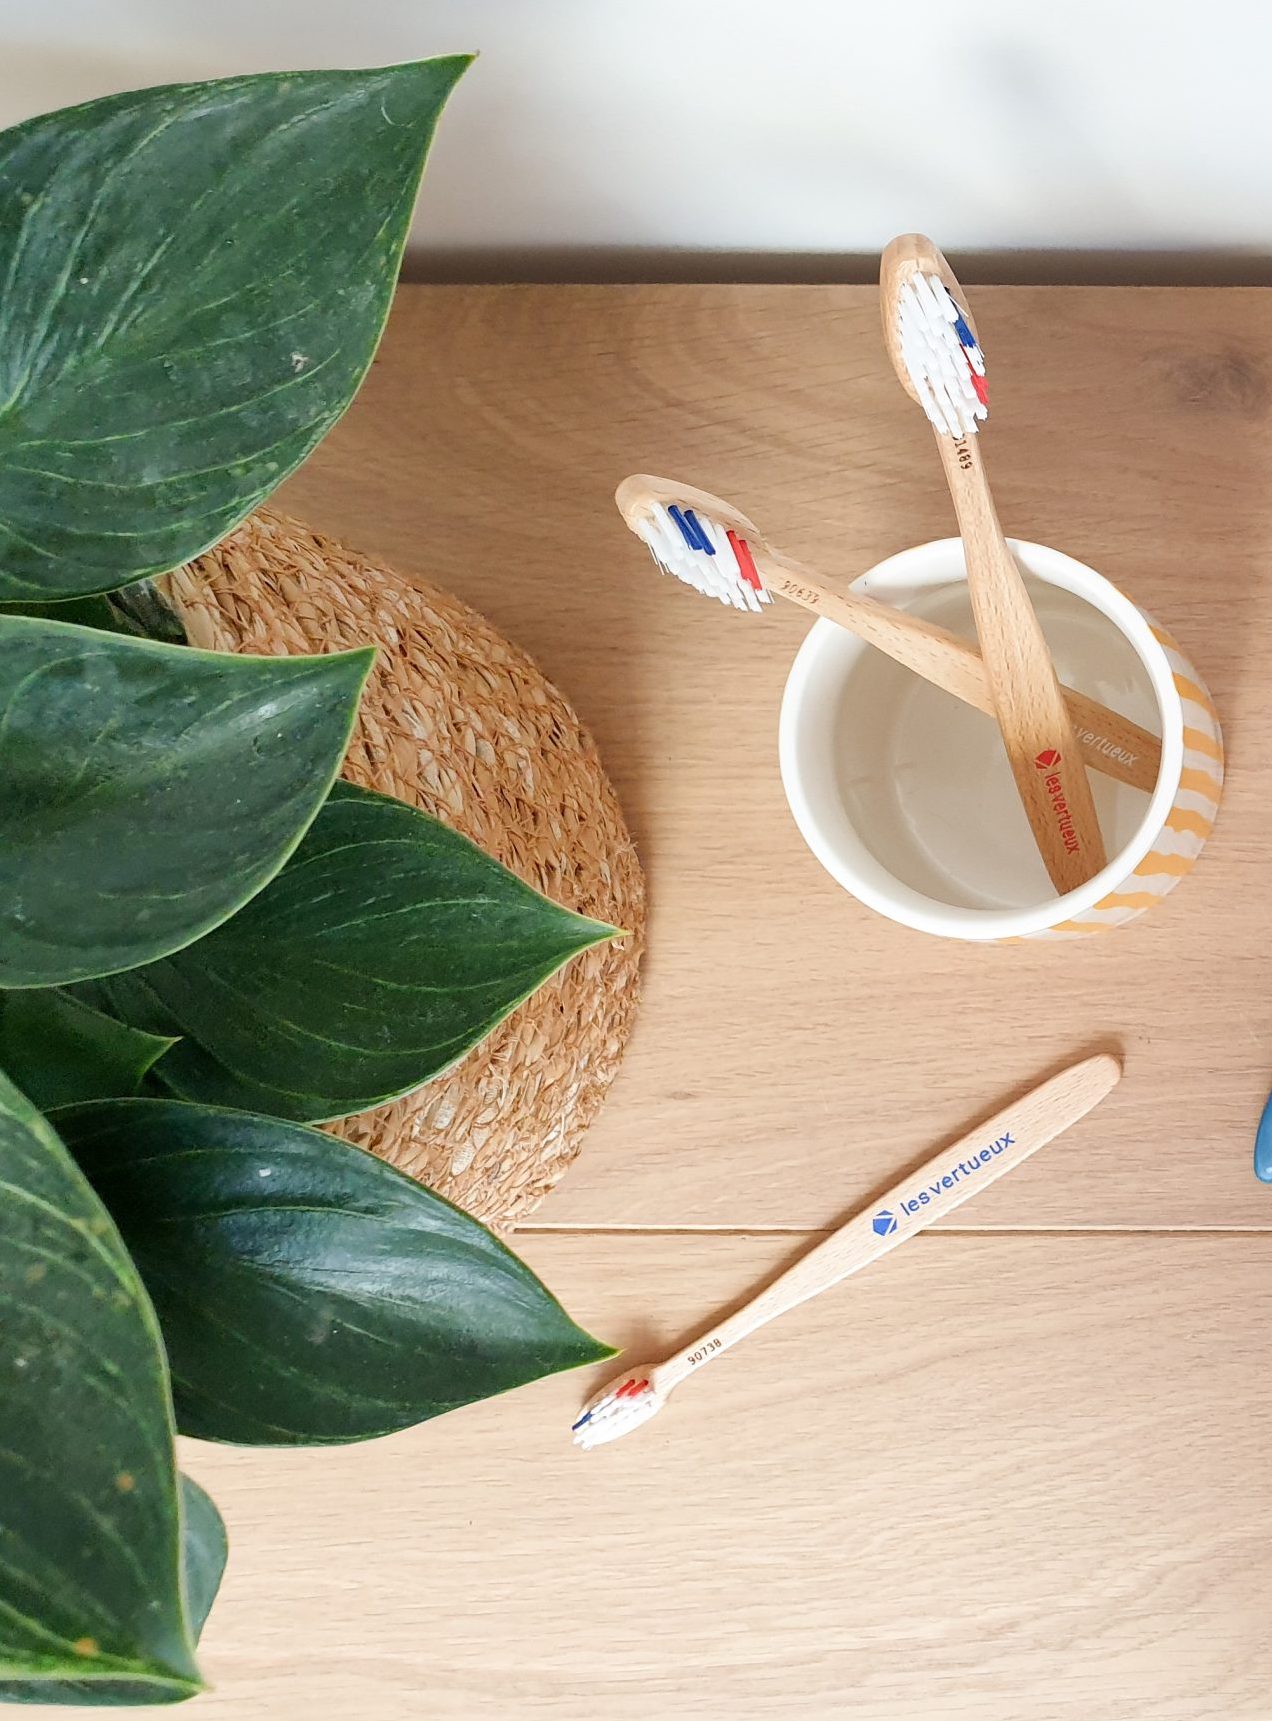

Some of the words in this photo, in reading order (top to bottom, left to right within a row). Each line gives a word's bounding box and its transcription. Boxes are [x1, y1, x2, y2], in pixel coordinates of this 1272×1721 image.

[900, 1192, 930, 1216] les
[929, 1131, 1015, 1195] vertueux
[688, 1338, 721, 1365] 90738
